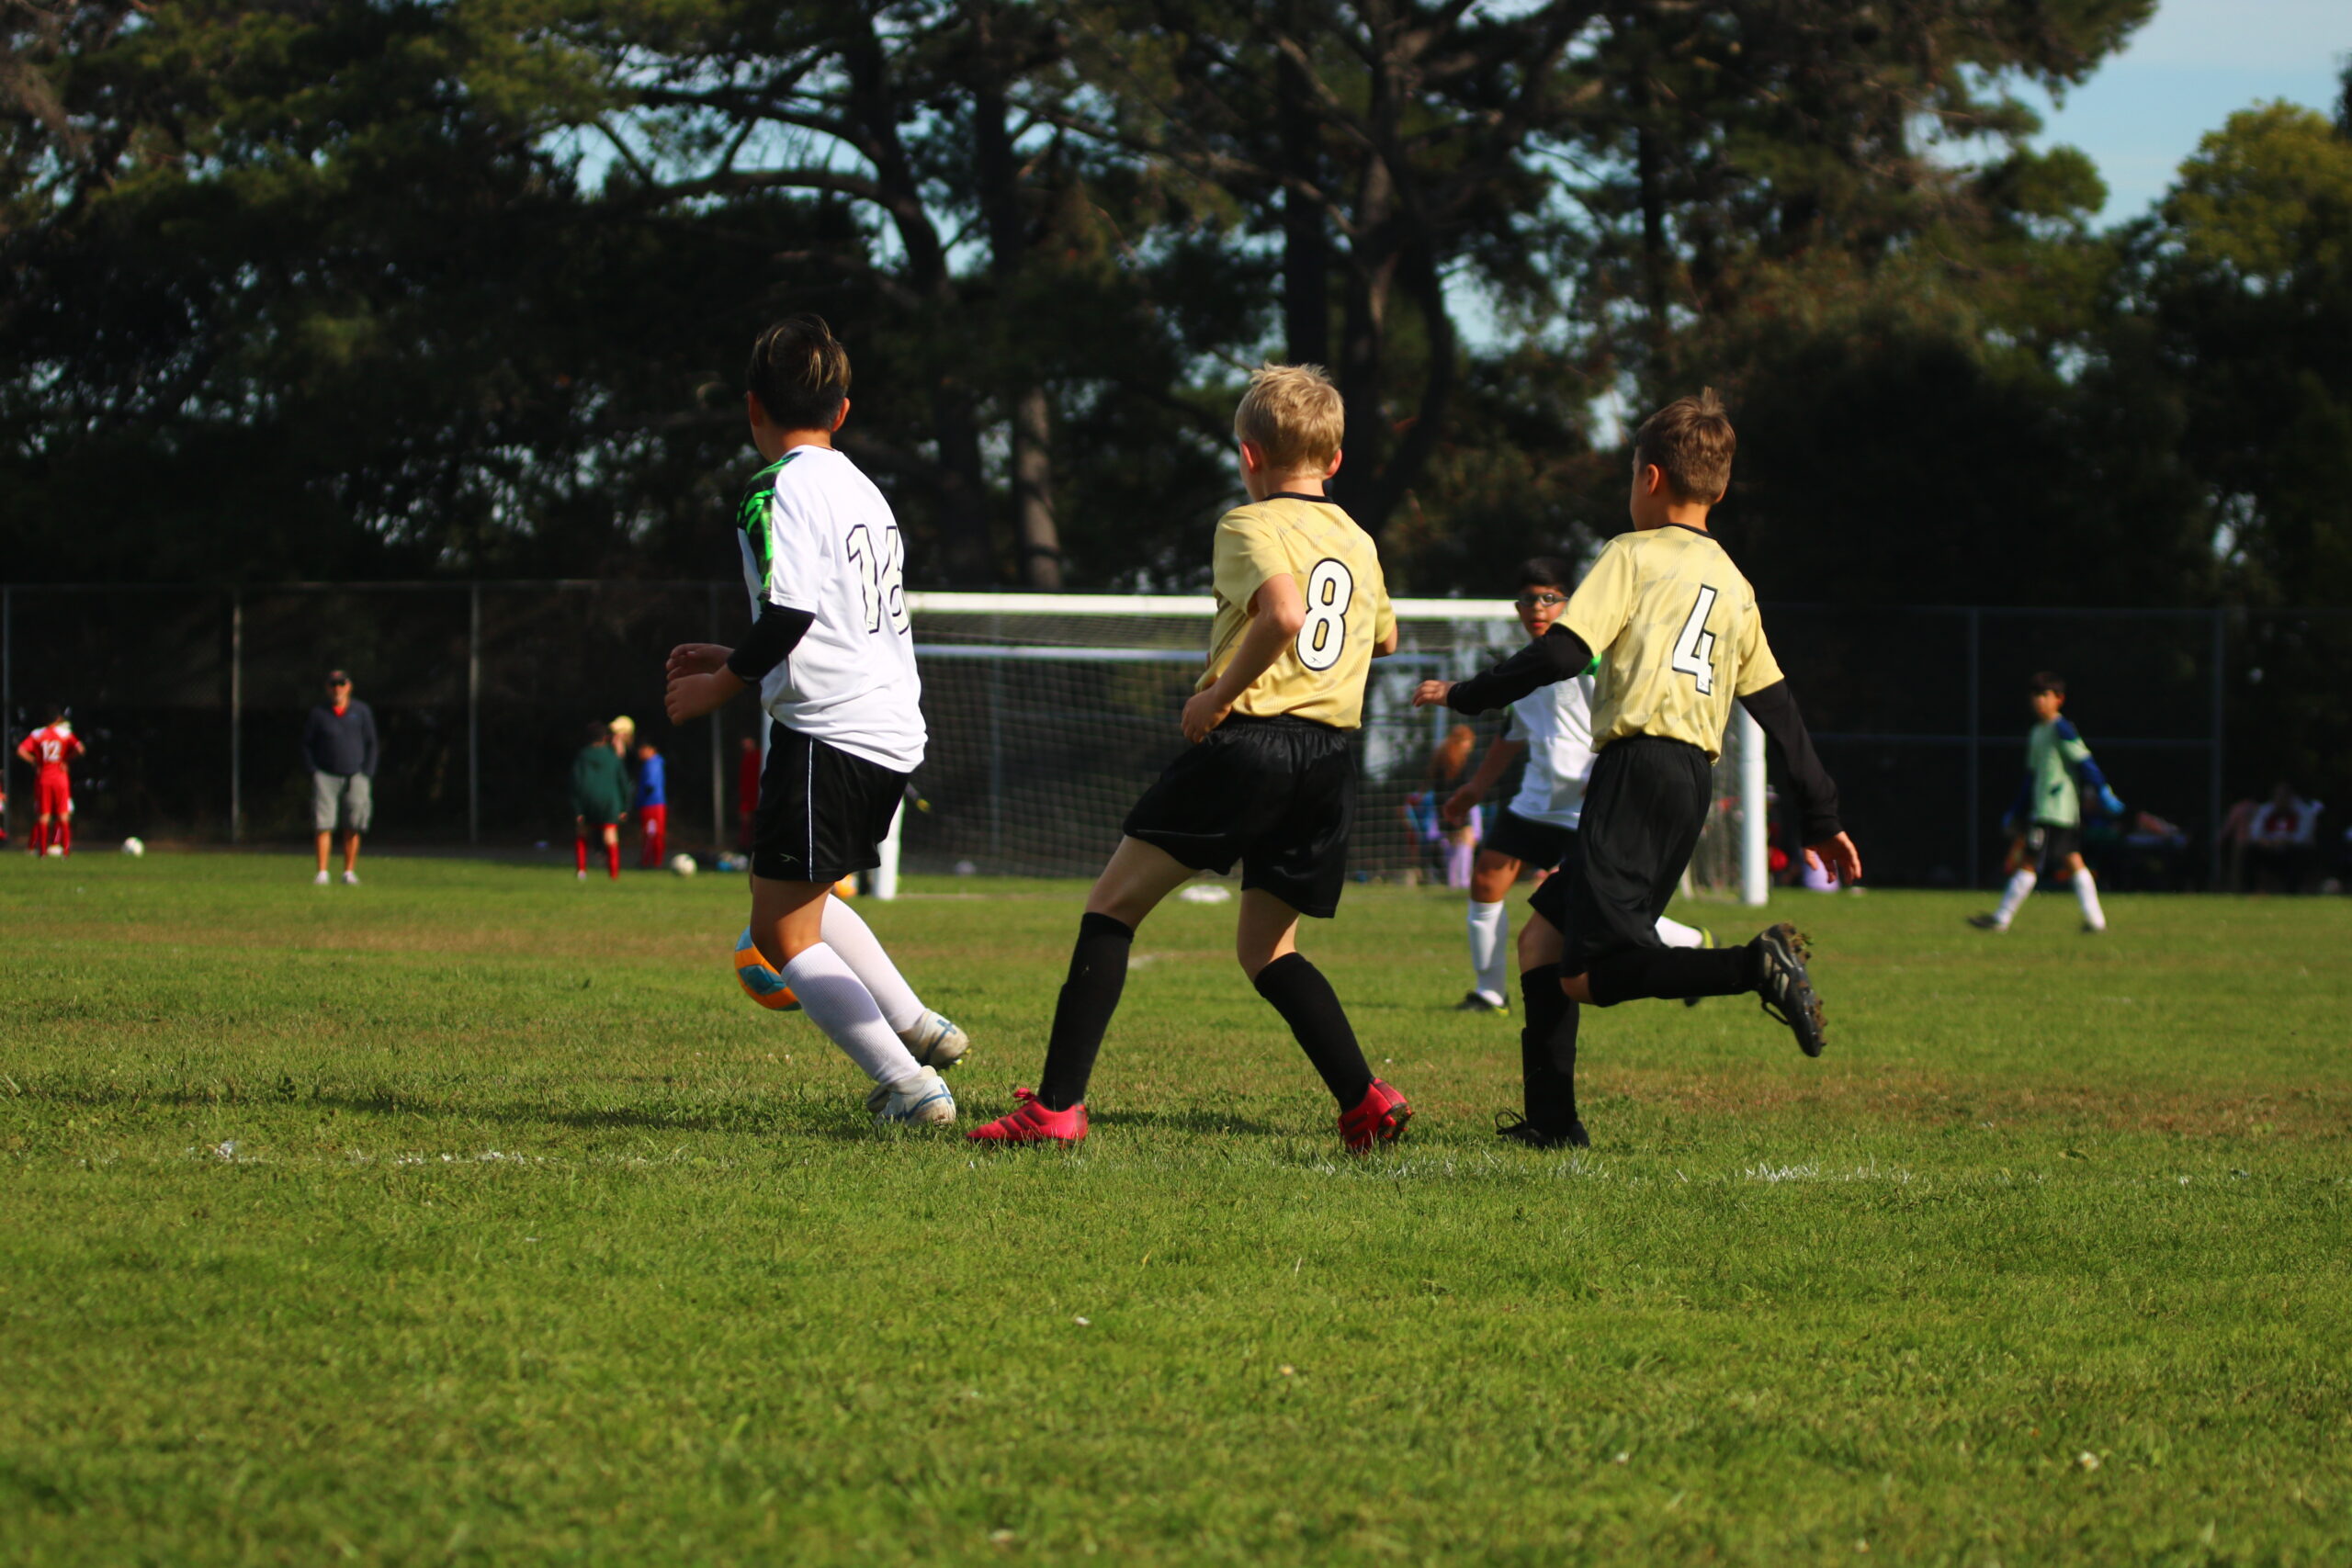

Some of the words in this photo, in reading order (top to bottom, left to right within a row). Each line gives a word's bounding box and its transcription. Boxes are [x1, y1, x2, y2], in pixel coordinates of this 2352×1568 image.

[846, 524, 910, 636] 16
[1296, 558, 1353, 671] 8
[1672, 583, 1718, 696] 4
[40, 739, 62, 762] 12
